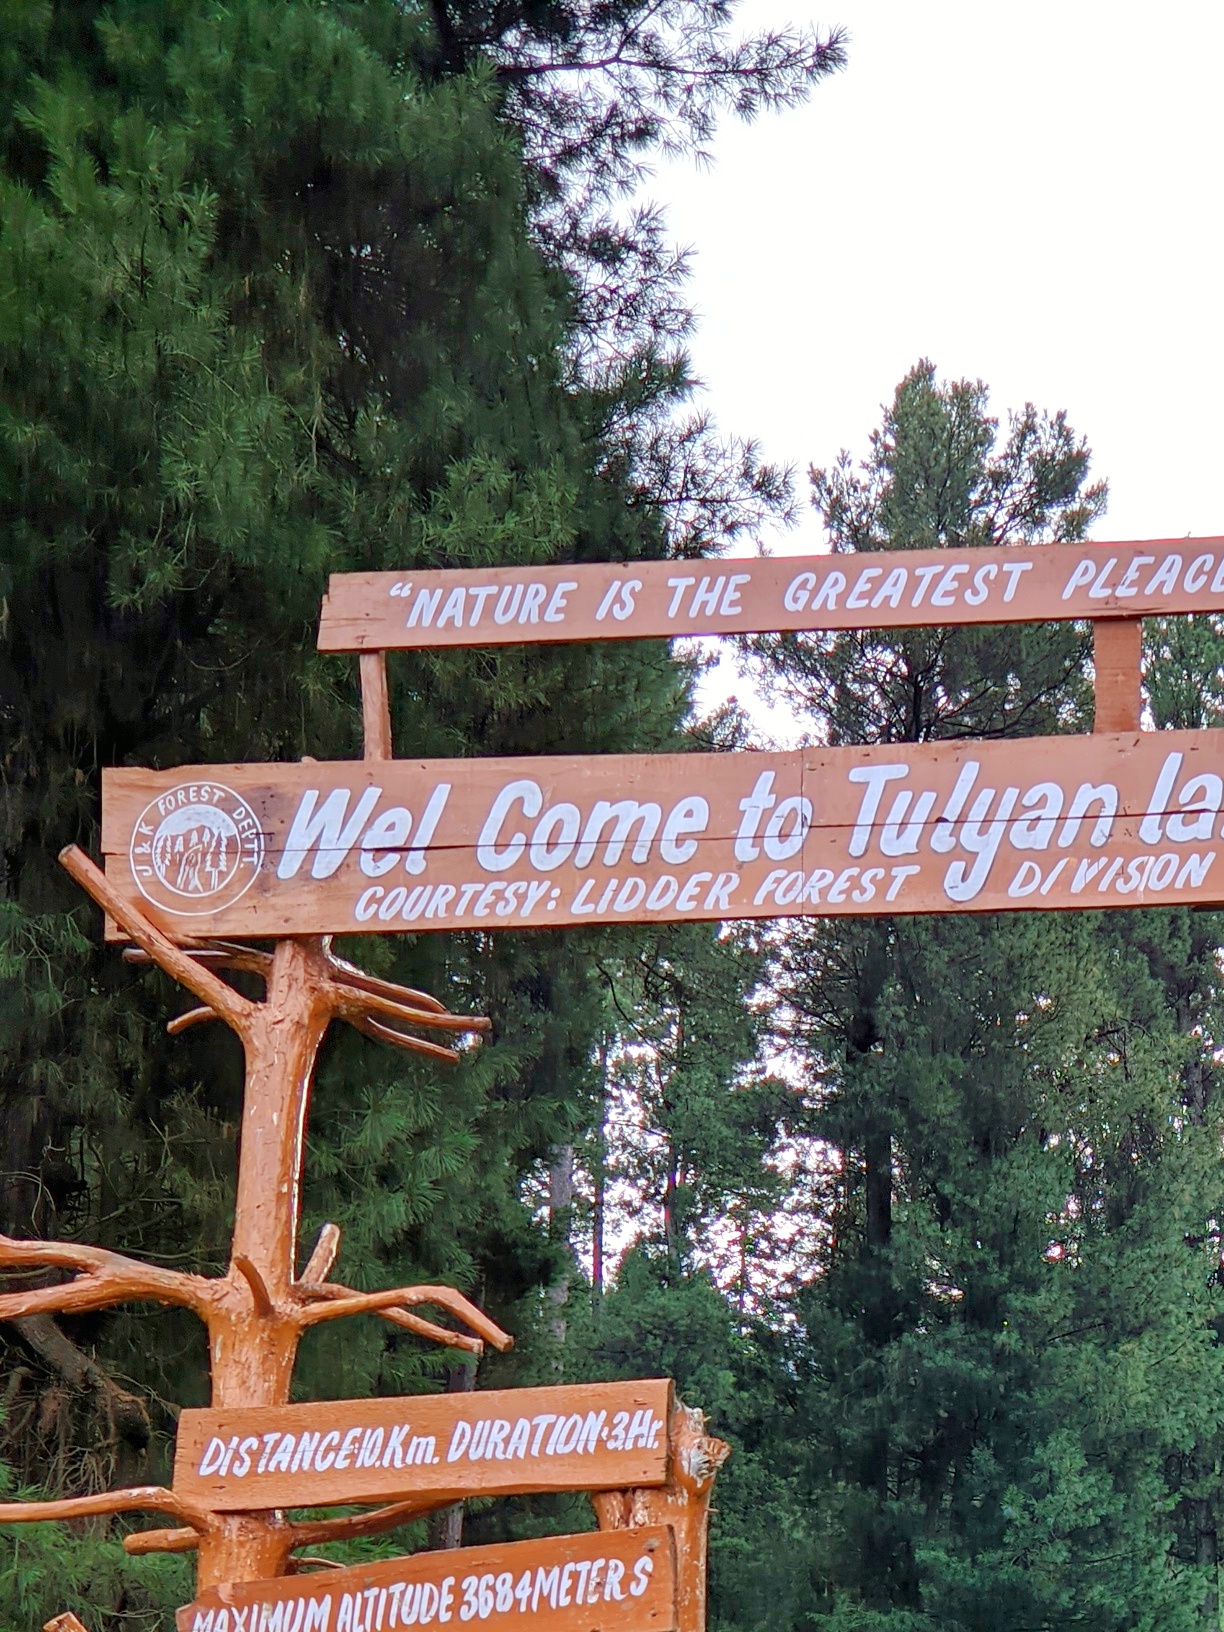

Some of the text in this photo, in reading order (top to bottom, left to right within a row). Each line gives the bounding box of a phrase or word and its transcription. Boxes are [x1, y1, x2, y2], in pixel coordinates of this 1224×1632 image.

[594, 577, 643, 622] IS
[666, 573, 752, 619] THE
[783, 560, 1034, 613] GREATEST
[156, 785, 226, 816] FOREST
[275, 782, 452, 880] Wel
[475, 778, 711, 873] Come
[734, 769, 815, 864] to
[847, 760, 1120, 903] Tulyan
[353, 879, 563, 923] COURTESY:
[570, 871, 743, 916] LIDDER
[753, 865, 922, 906] FOREST
[1007, 851, 1217, 899] DIVISION
